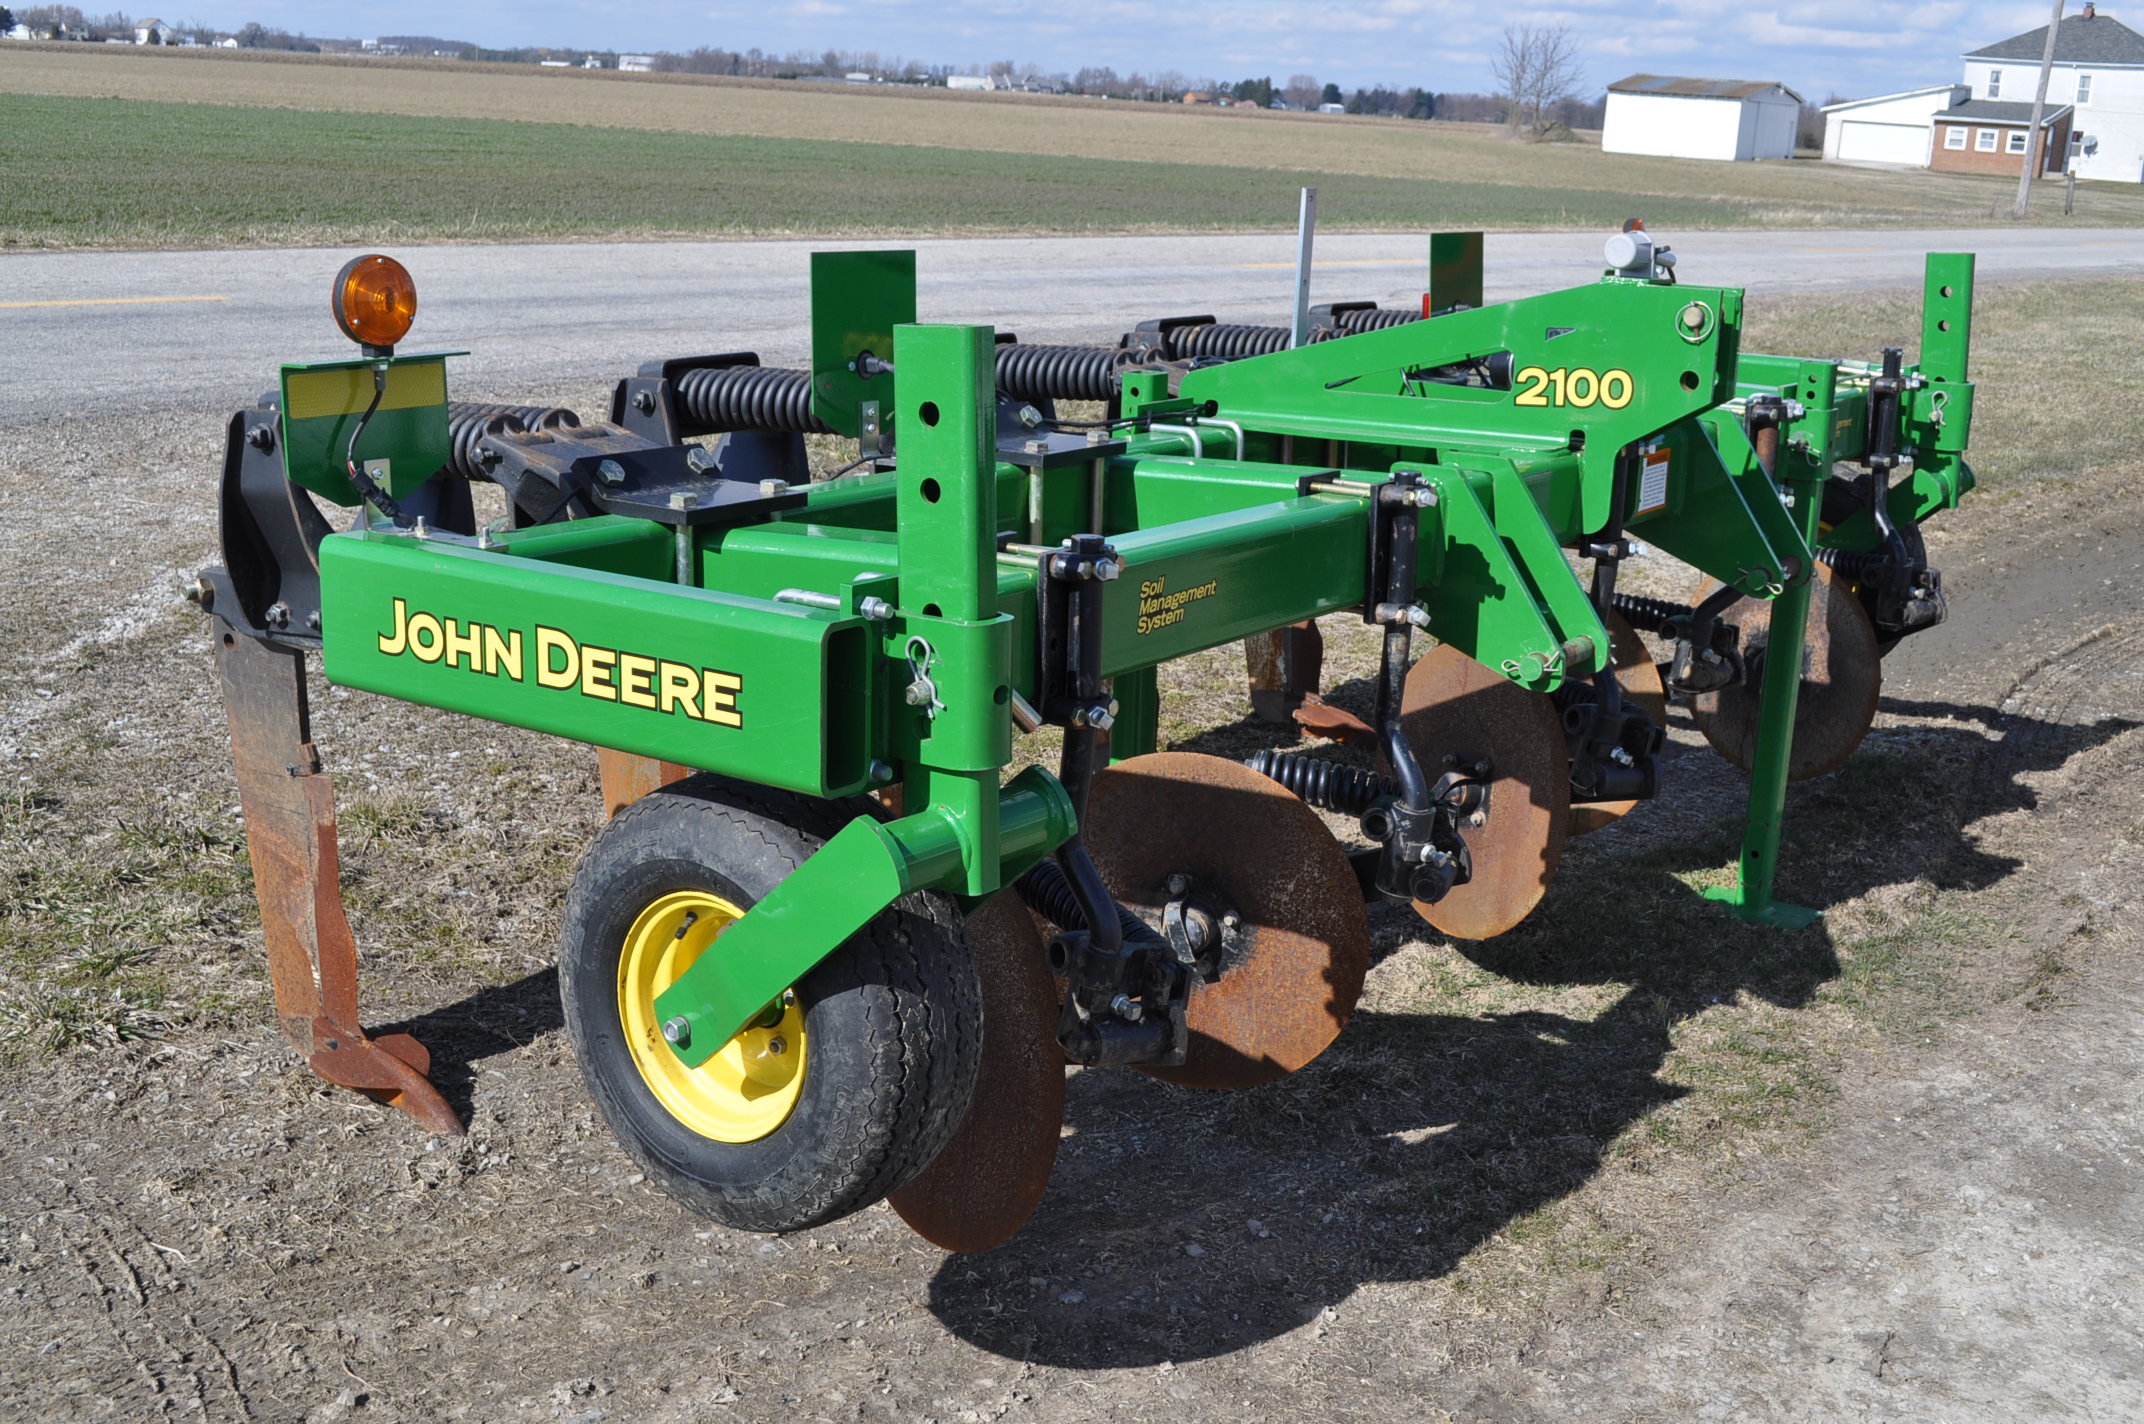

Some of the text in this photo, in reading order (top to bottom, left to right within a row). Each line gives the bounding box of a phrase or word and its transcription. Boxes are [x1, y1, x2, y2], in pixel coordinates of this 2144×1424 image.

[1515, 366, 1634, 410] 2100
[1138, 579, 1217, 616] Management
[1139, 575, 1165, 598] Soil
[1137, 607, 1185, 635] System
[378, 597, 743, 730] JOHN DEERE
